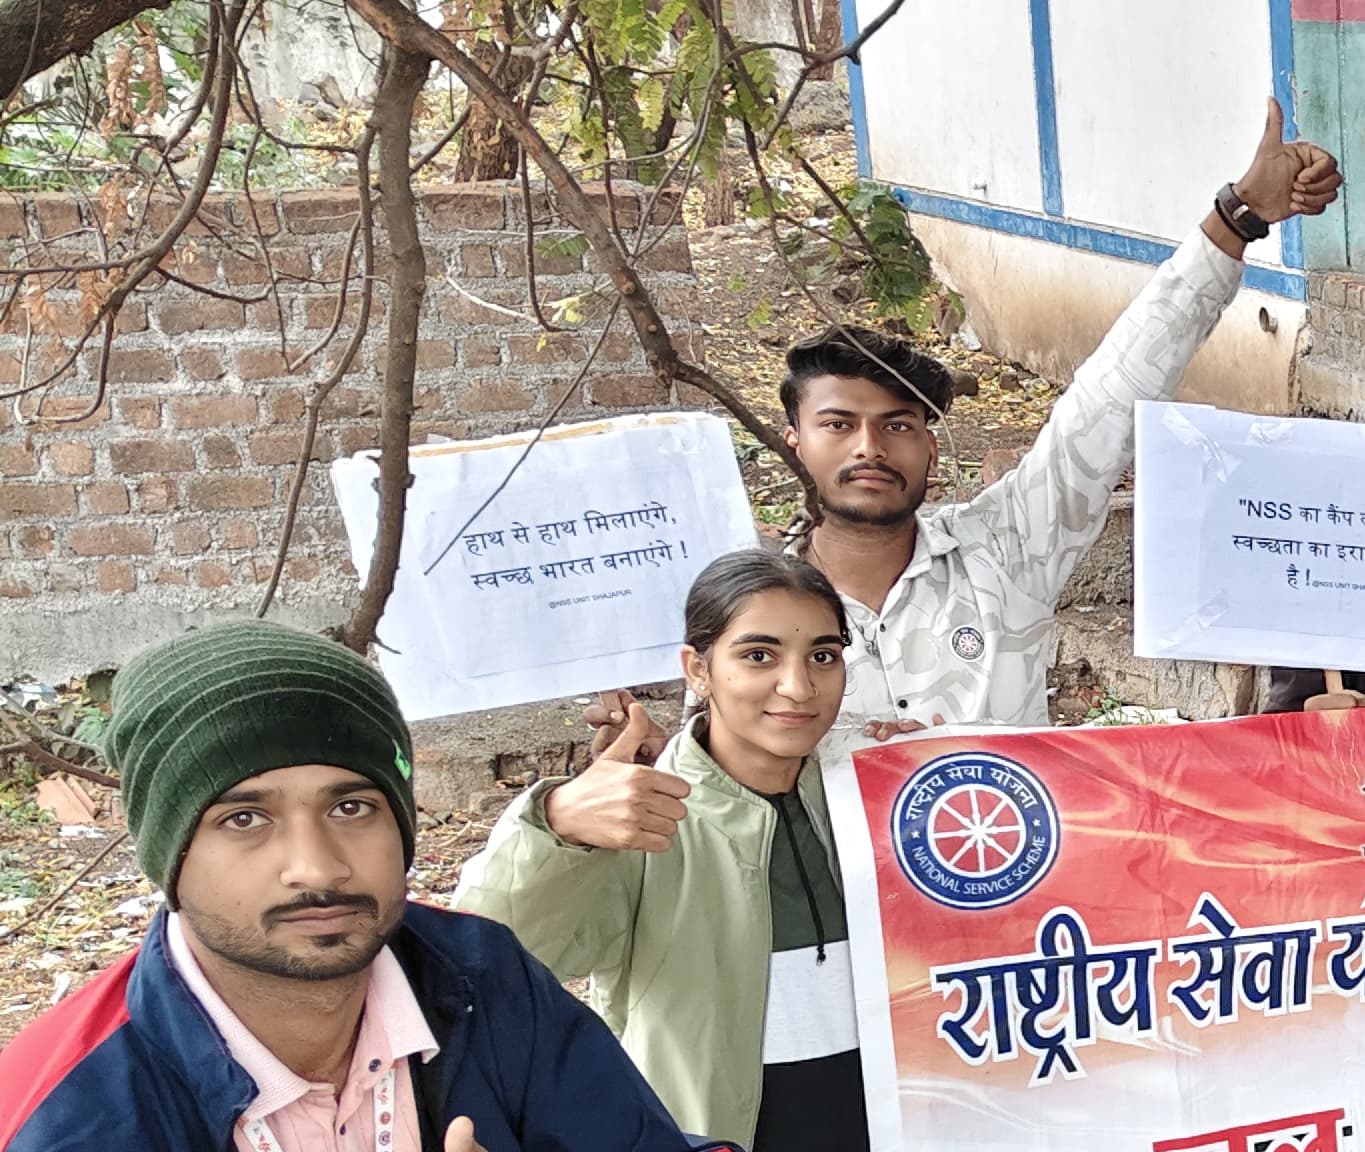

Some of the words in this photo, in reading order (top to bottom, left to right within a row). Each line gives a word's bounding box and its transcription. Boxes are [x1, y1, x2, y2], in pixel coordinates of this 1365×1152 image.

[463, 528, 505, 557] हाथ
[511, 520, 531, 545] से
[539, 518, 577, 545] हाथ
[584, 501, 679, 538] मिलाएंगे,
[1299, 506, 1320, 524] का
[1326, 503, 1353, 527] कैंप
[1232, 534, 1303, 557] स्वच्छता
[1309, 541, 1330, 558] का
[470, 566, 536, 593] स्वच्छ
[540, 556, 596, 581] भारत
[904, 771, 947, 822] राष्ट्रीय
[946, 762, 984, 784] सेवा
[989, 764, 1038, 811] योजना
[911, 845, 964, 896] NATIONAL
[962, 872, 1015, 897] SERVICE
[1012, 835, 1048, 883] SCHEME
[935, 914, 1158, 1078] राष्ट्रीय
[1171, 898, 1315, 1022] सेवा
